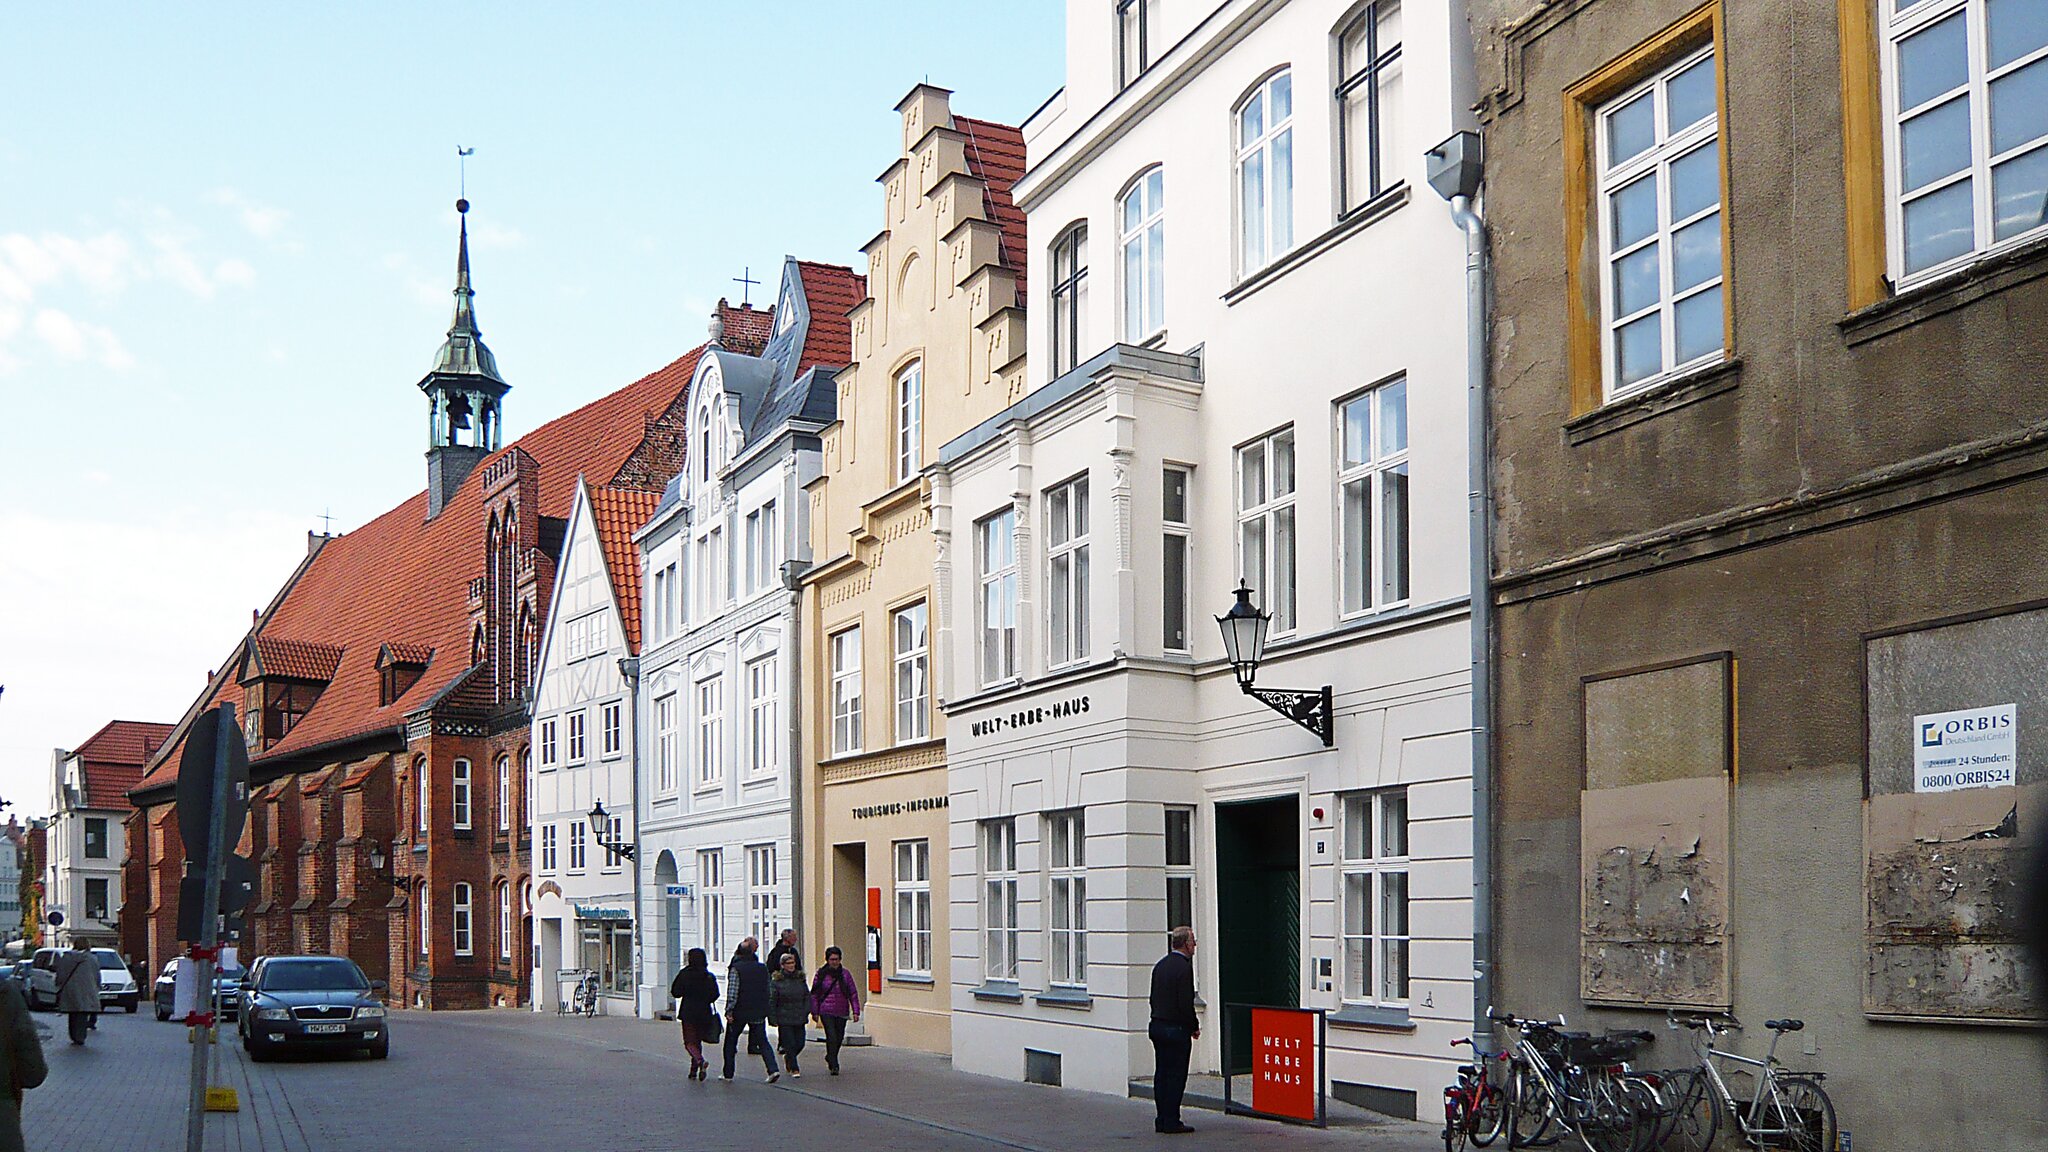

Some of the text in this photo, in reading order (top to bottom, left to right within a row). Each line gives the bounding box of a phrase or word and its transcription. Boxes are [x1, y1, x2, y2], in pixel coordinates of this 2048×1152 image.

[1945, 714, 2010, 734] ORBIS
[1945, 731, 2010, 746] Deutschland GmbH
[1958, 756, 1969, 766] 24
[1971, 753, 2011, 765] Stunden:
[1922, 769, 2010, 788] 0800/ORBIS24
[1263, 1036, 1300, 1049] WELT
[1265, 1054, 1300, 1067] ERBE
[1264, 1071, 1300, 1085] HAUS
